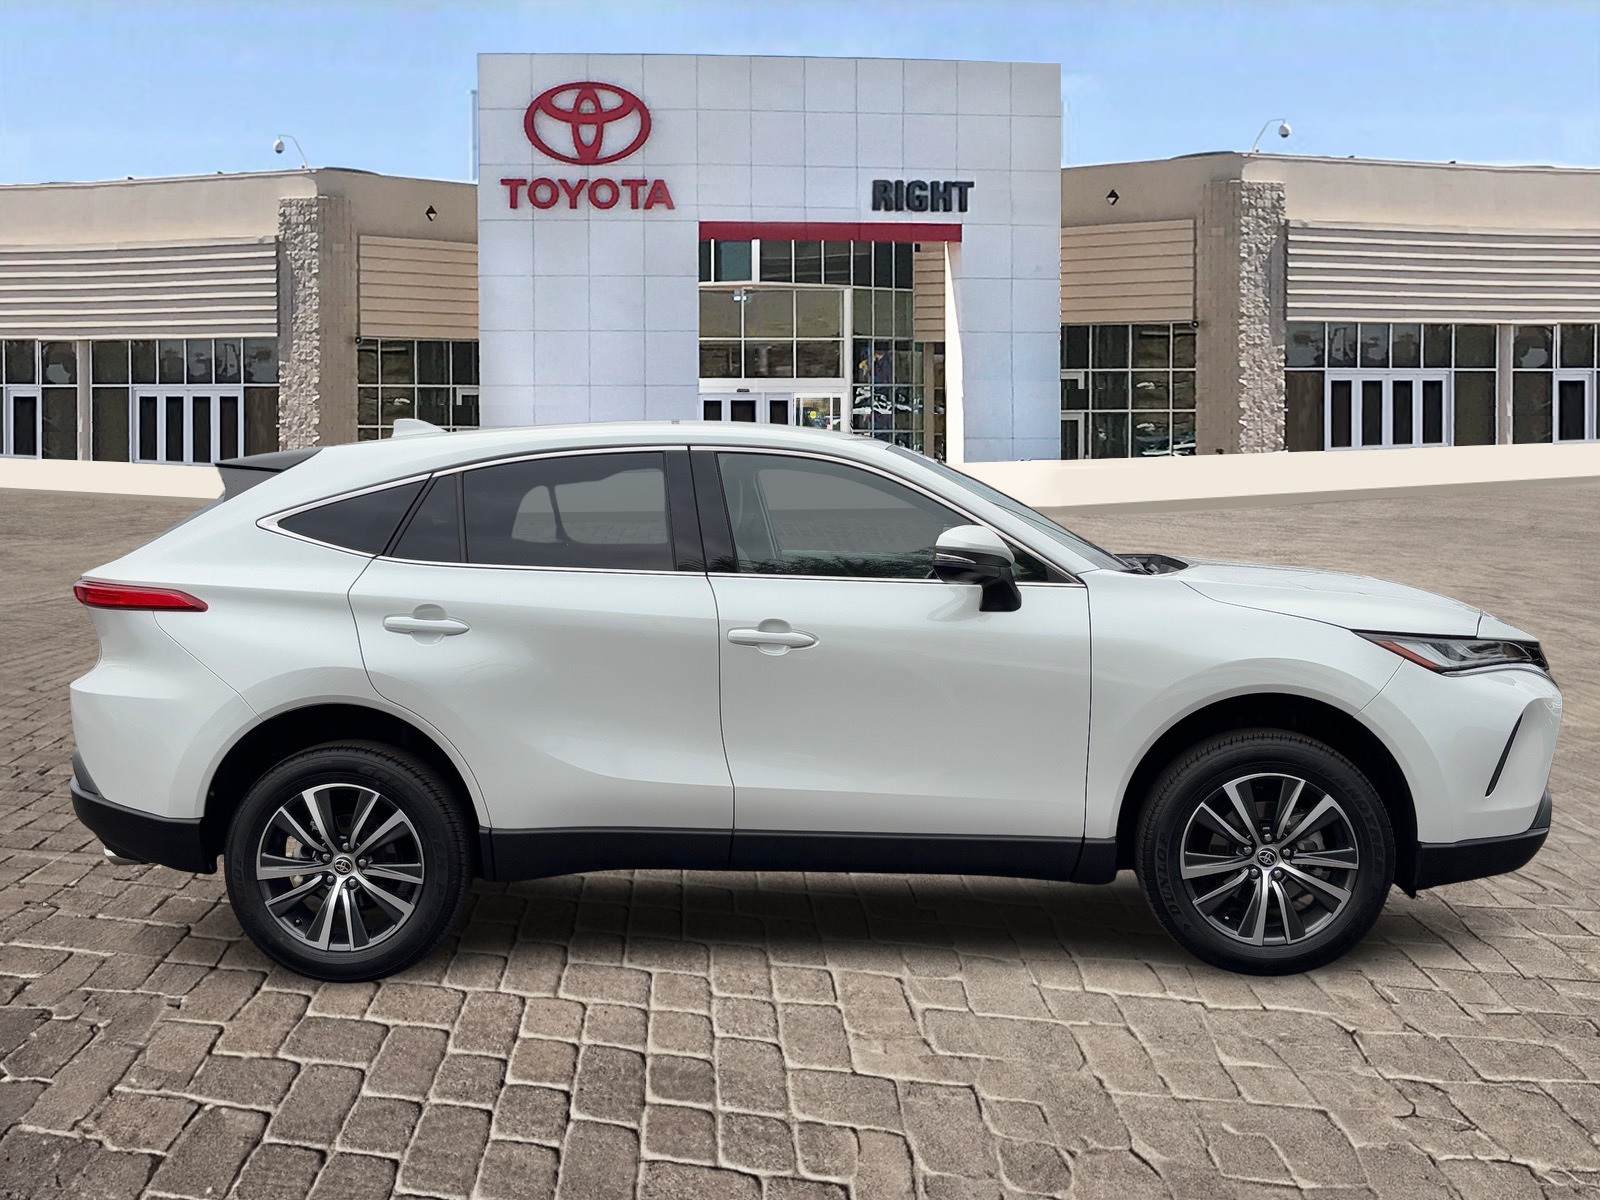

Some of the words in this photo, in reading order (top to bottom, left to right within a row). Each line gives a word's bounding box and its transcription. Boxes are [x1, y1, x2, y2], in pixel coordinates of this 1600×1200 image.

[501, 179, 675, 210] TOYOTA
[872, 180, 975, 213] RIGHT
[1155, 832, 1181, 917] DUNLOP
